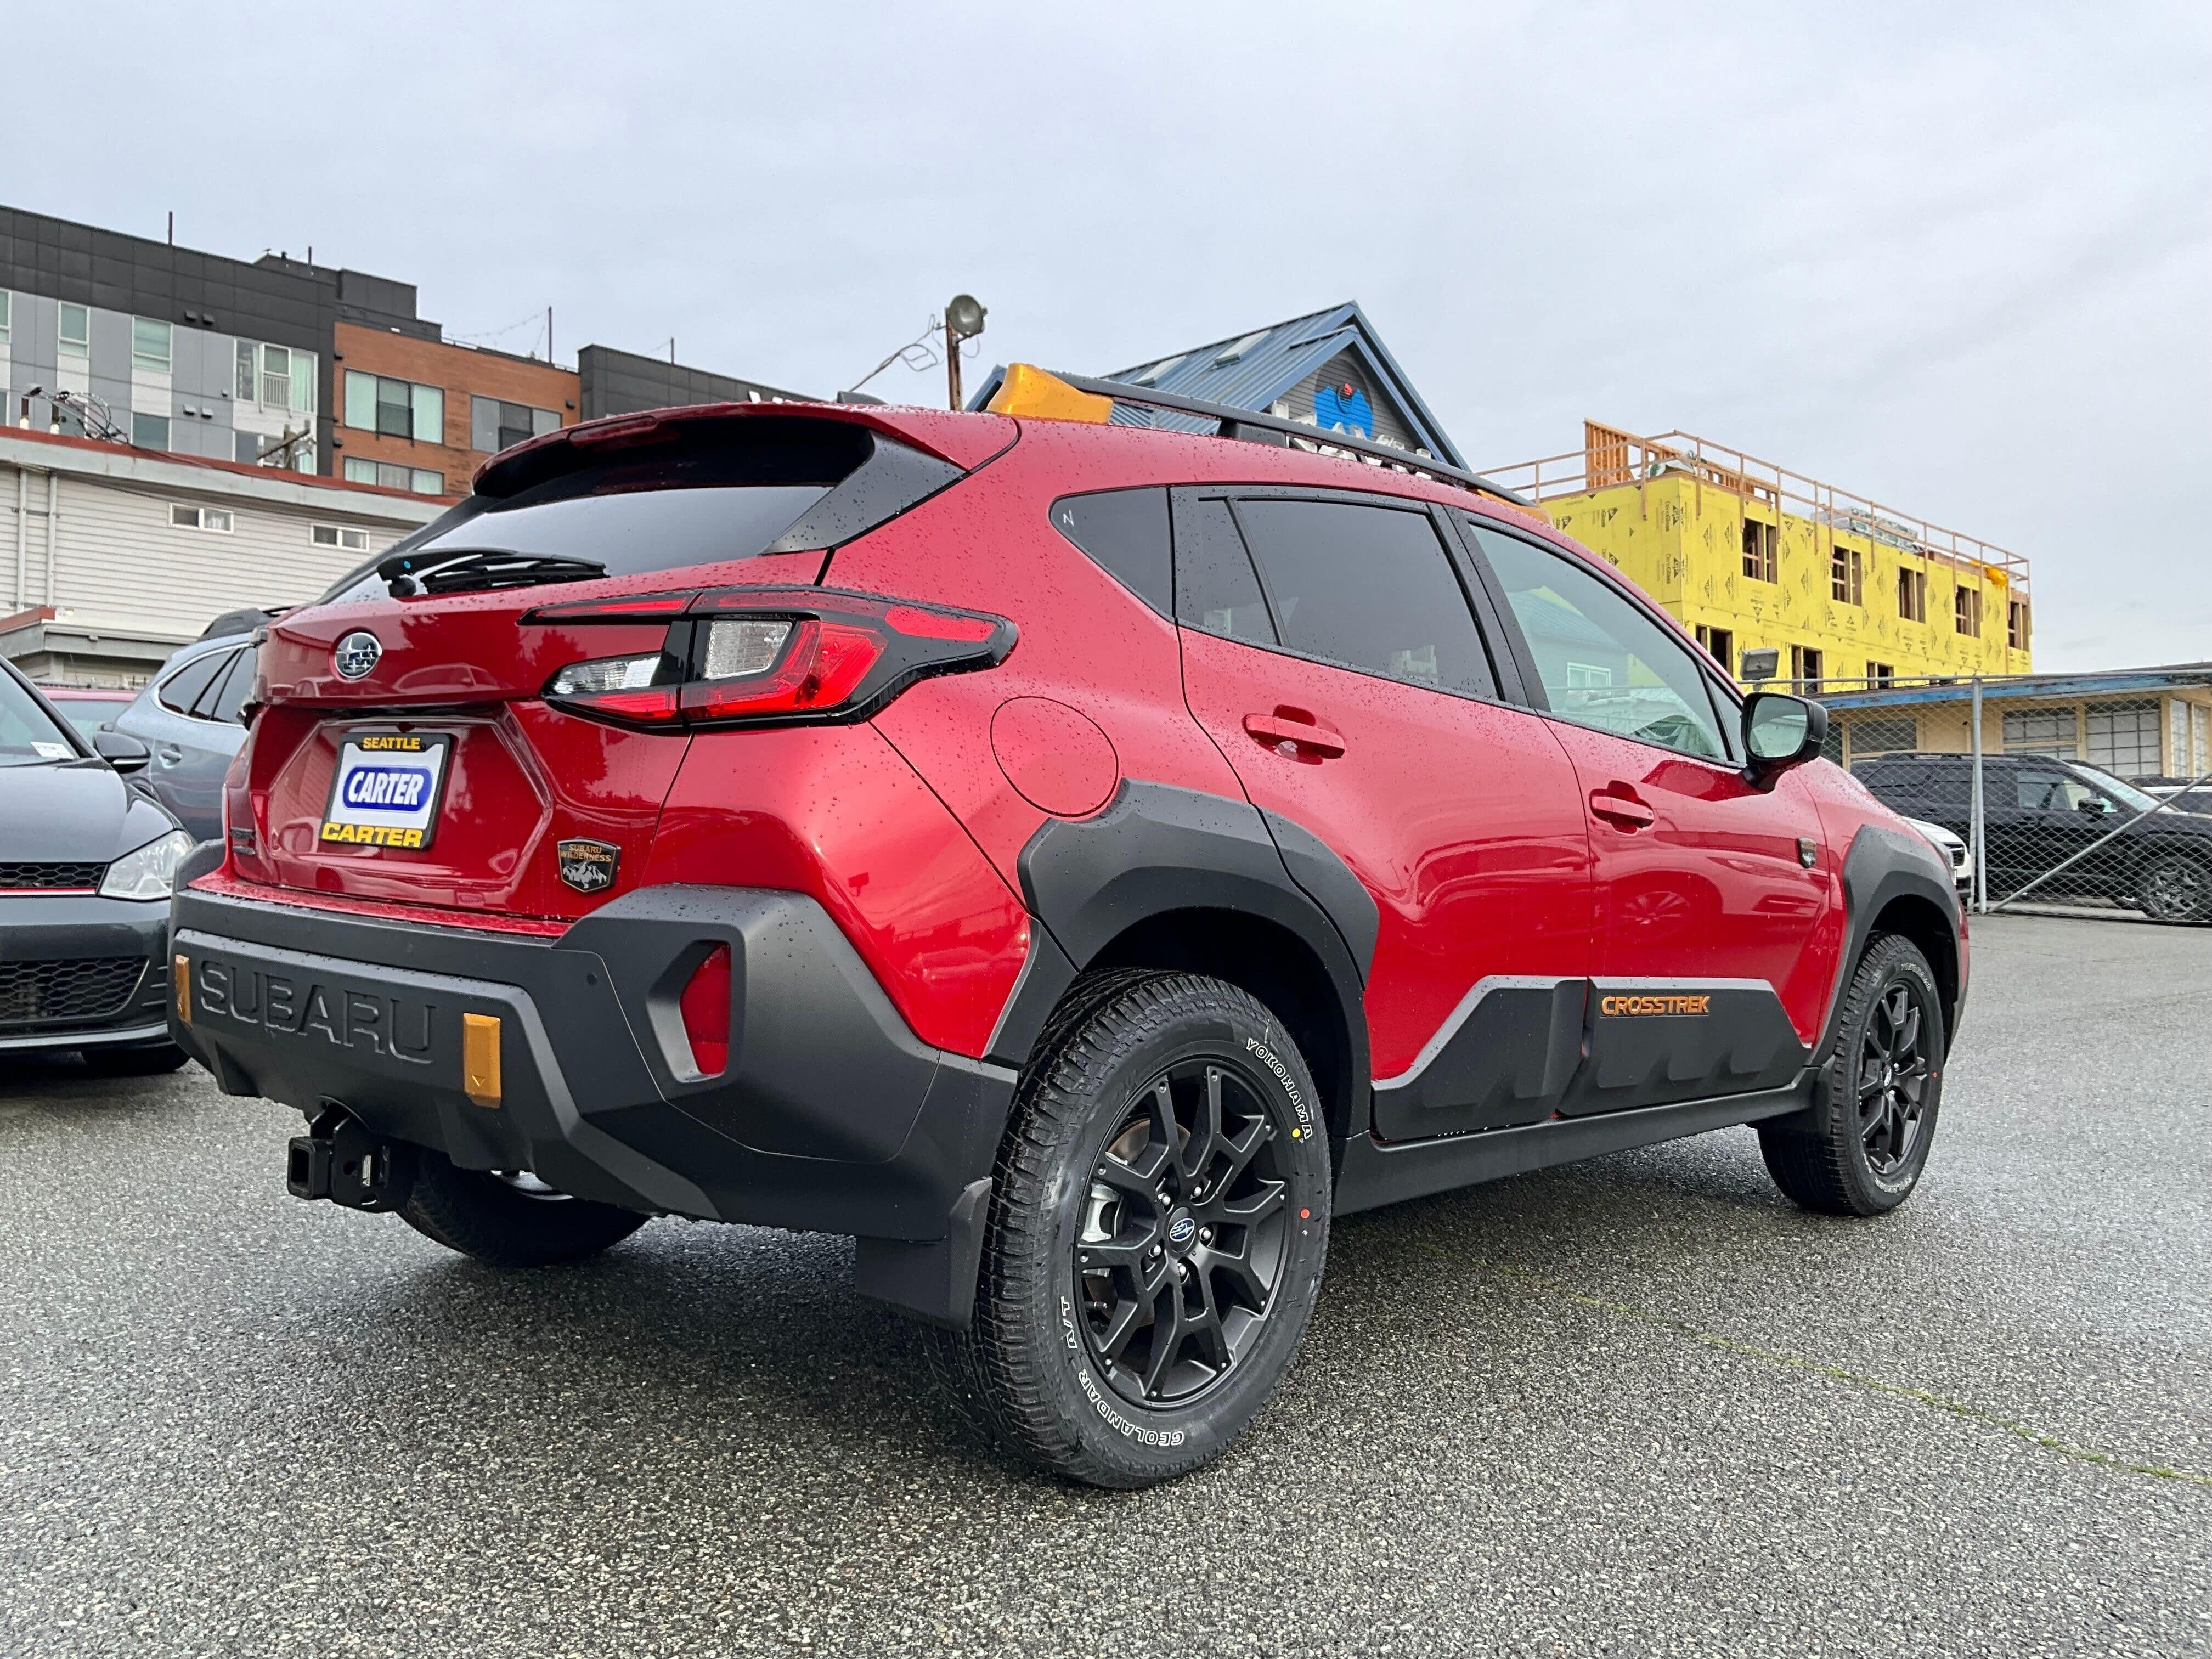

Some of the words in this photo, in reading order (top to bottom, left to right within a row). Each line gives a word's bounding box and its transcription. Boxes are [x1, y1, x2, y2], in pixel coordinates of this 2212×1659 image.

[363, 737, 421, 750] SEATTLE
[348, 771, 425, 806] CARTER
[321, 823, 423, 848] CARTER
[560, 850, 612, 862] WILDERNESS
[569, 844, 602, 854] SUBARU
[199, 960, 437, 1064] SUBARU
[1601, 995, 1711, 1015] CROSSTREK
[1245, 1037, 1313, 1140] YOKOHAMA
[1078, 1368, 1184, 1446] GEOLANDAR
